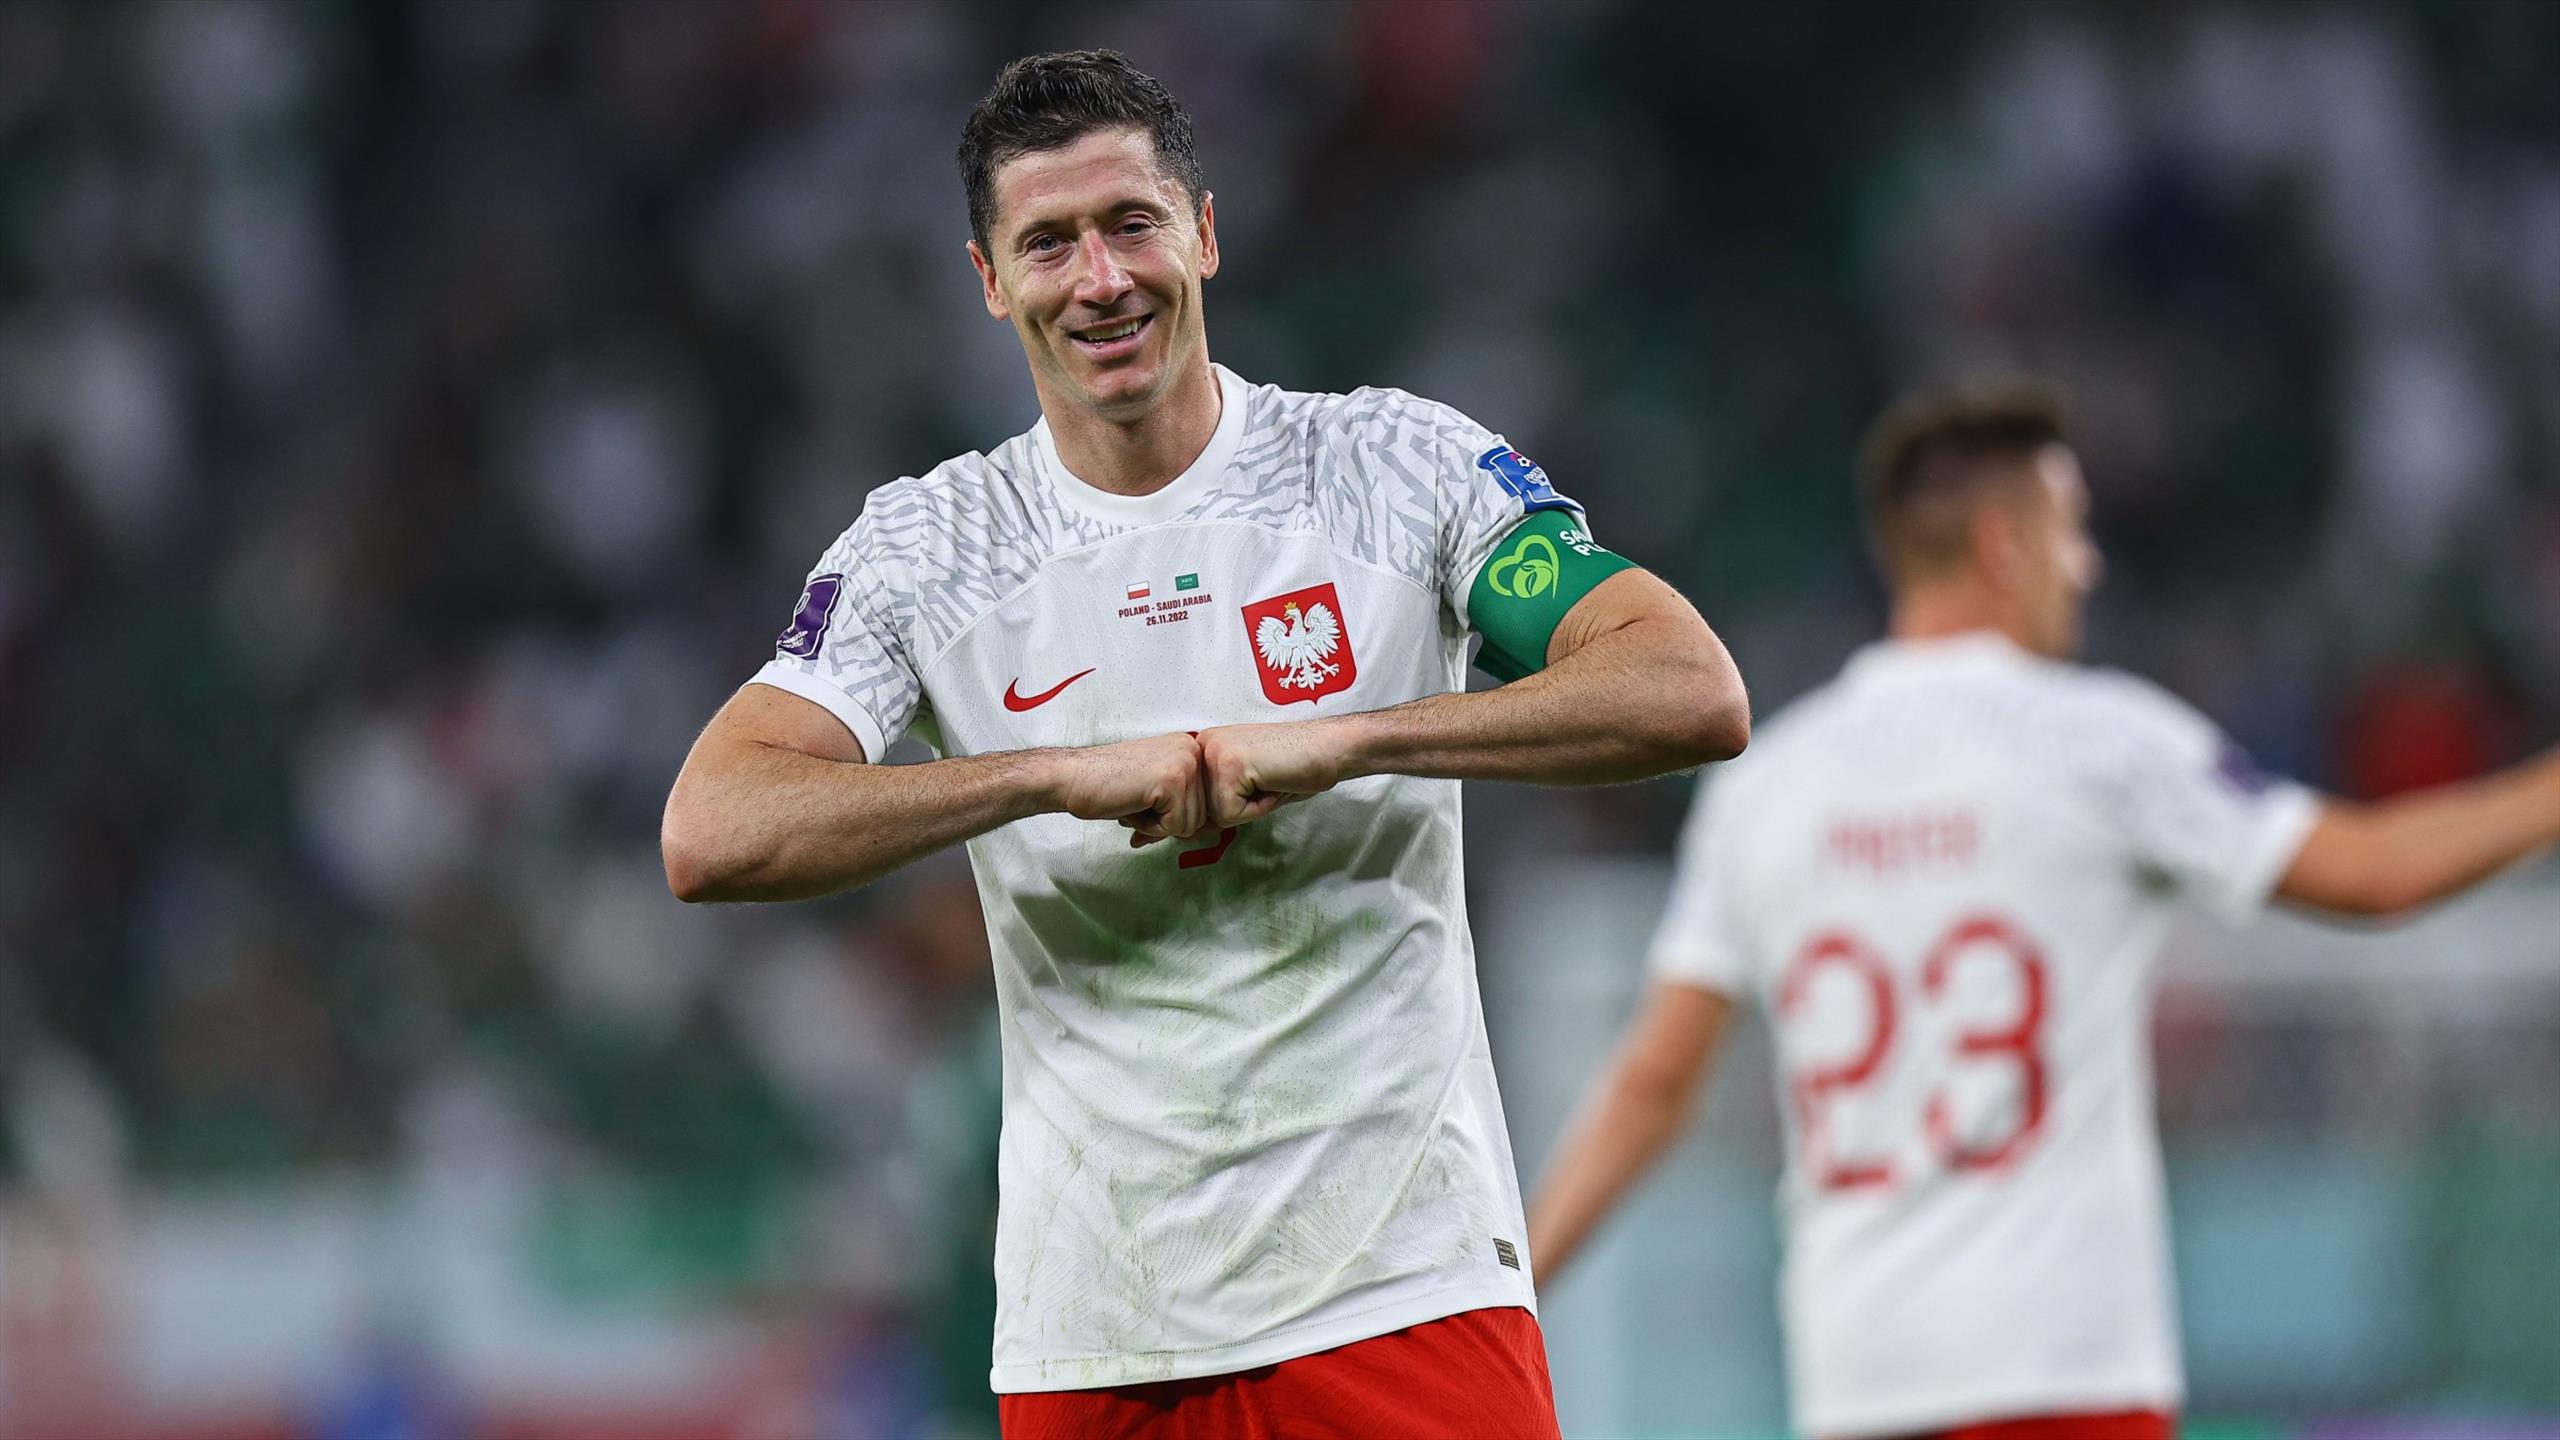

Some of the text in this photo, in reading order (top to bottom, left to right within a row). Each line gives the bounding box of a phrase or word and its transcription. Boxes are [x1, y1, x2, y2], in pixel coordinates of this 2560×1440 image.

[1118, 605, 1150, 618] POLAND
[1156, 599, 1181, 611] SAUDI
[1182, 594, 1212, 607] ARABIA
[1146, 610, 1188, 626] 26.11.2022
[1776, 912, 2054, 1196] 23
